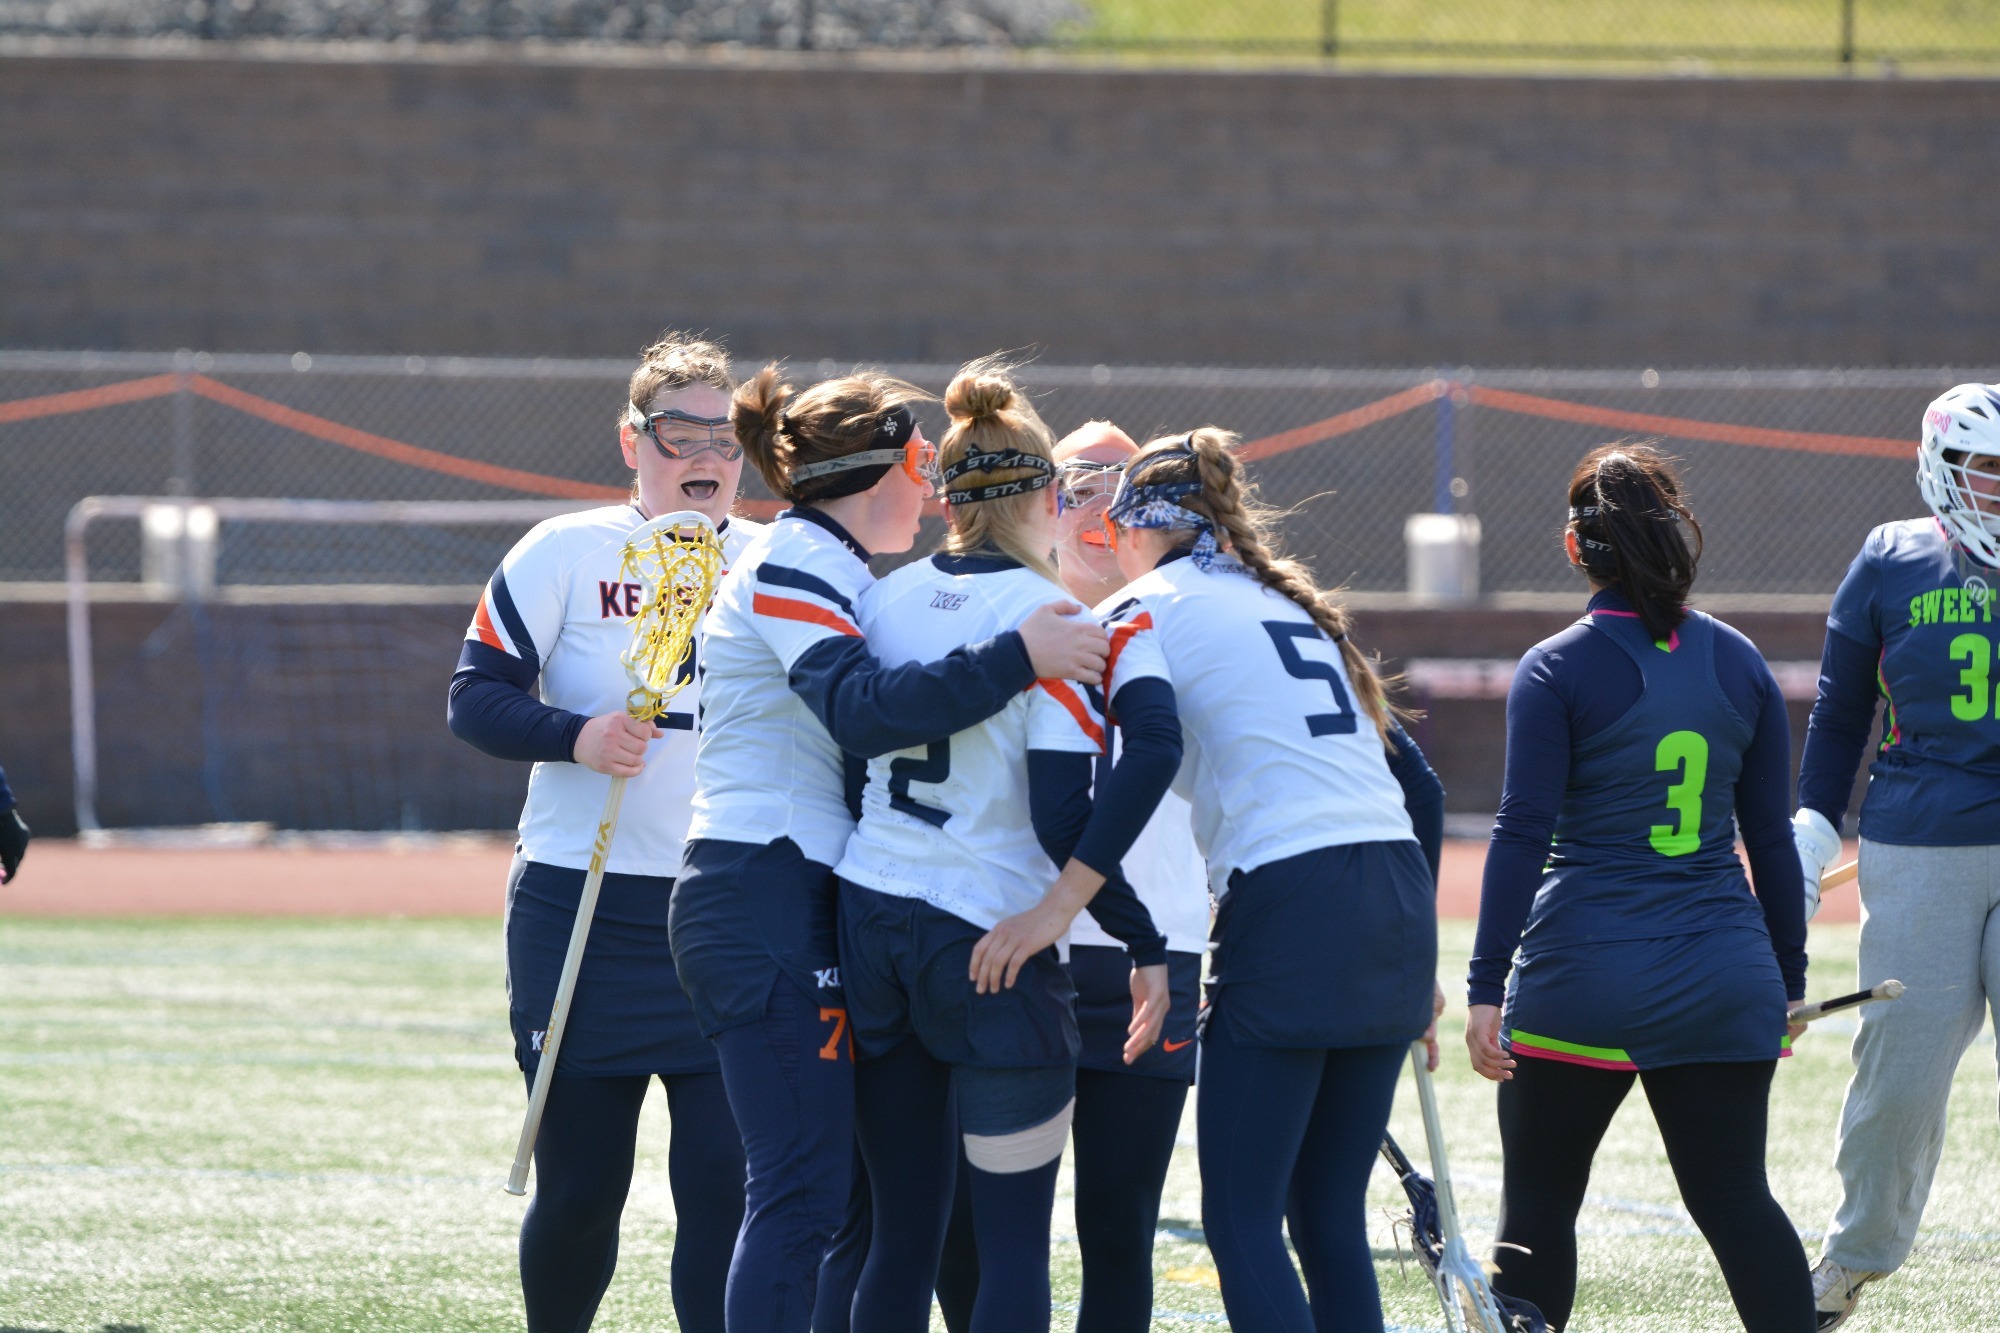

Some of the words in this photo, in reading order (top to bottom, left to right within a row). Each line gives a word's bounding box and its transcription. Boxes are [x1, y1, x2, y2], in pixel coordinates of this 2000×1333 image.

[967, 453, 1005, 469] STX
[1023, 455, 1051, 473] STX
[949, 491, 973, 504] STX
[984, 481, 1023, 499] STX
[1583, 506, 1602, 517] ST
[1908, 587, 1997, 628] SWEET
[1262, 620, 1358, 738] 5
[888, 738, 950, 829] 2
[1649, 731, 1709, 857] 3
